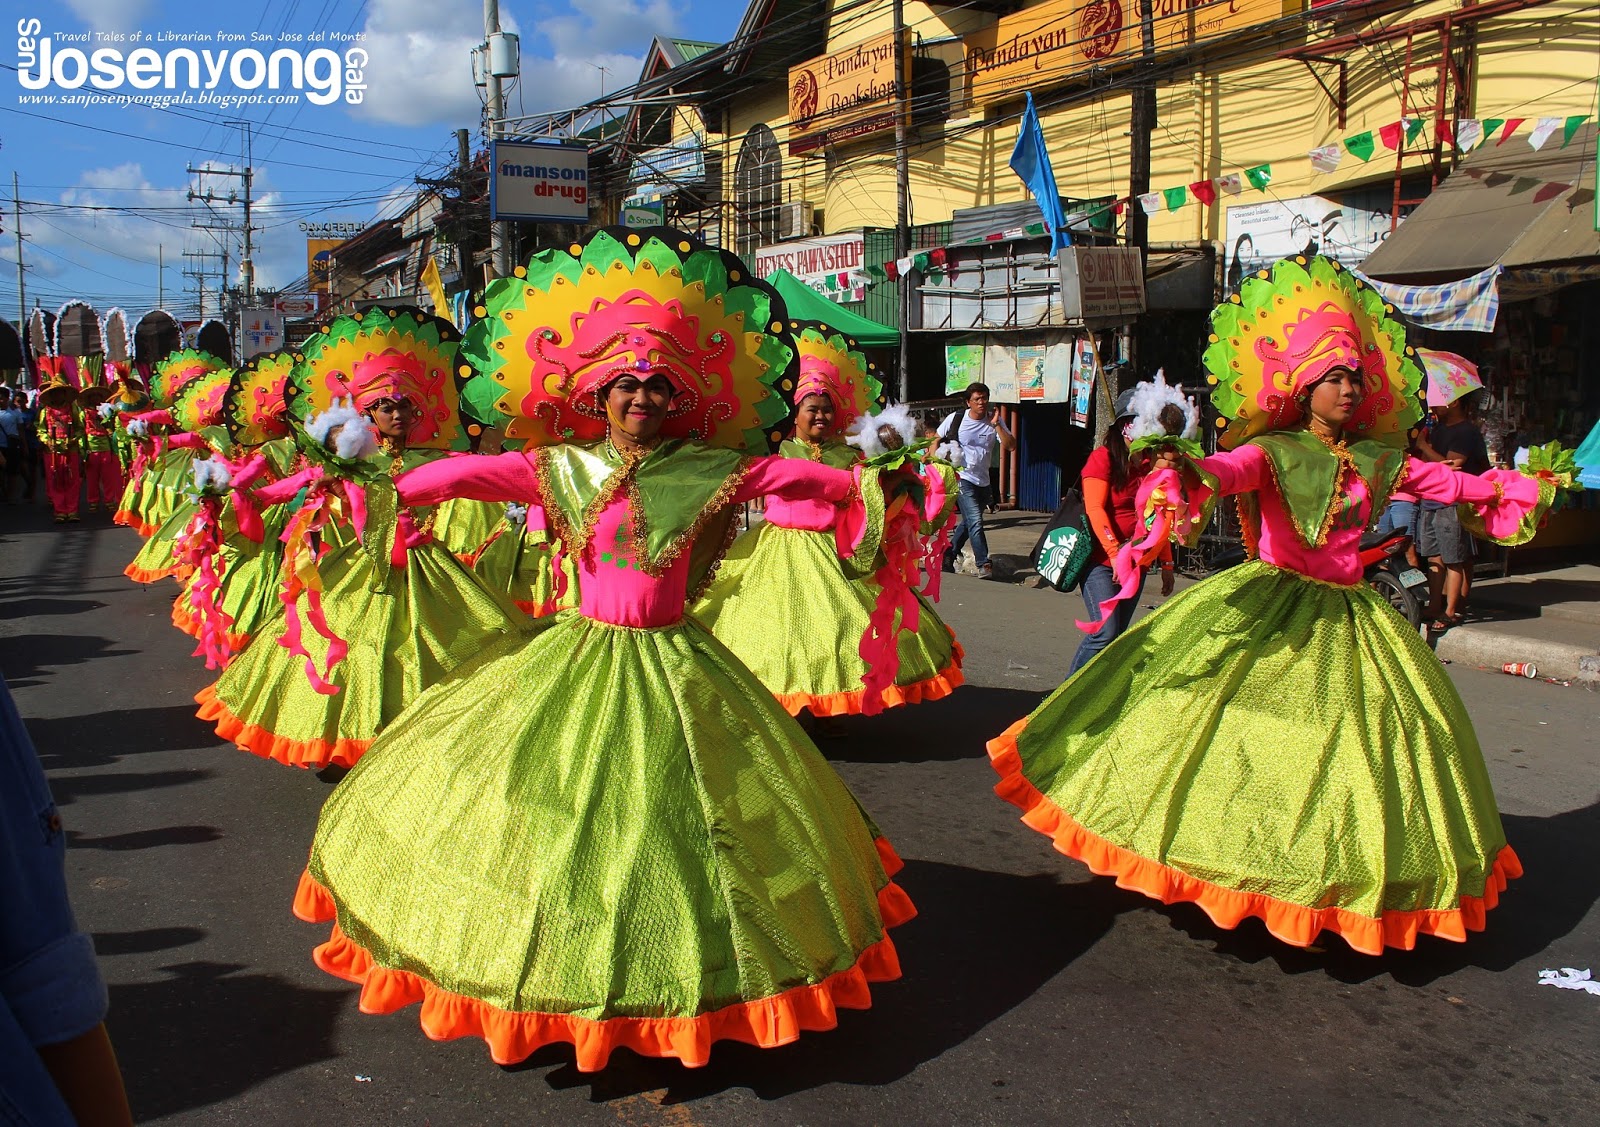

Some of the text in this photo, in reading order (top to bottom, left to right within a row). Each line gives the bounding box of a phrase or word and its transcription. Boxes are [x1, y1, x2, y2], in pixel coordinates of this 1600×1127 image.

[966, 28, 1067, 81] Pandayan
[502, 163, 587, 181] manson
[534, 181, 587, 204] drug
[636, 216, 659, 225] Smart
[756, 240, 864, 280] REYES PAWNSHOP
[245, 329, 279, 337] Generika
